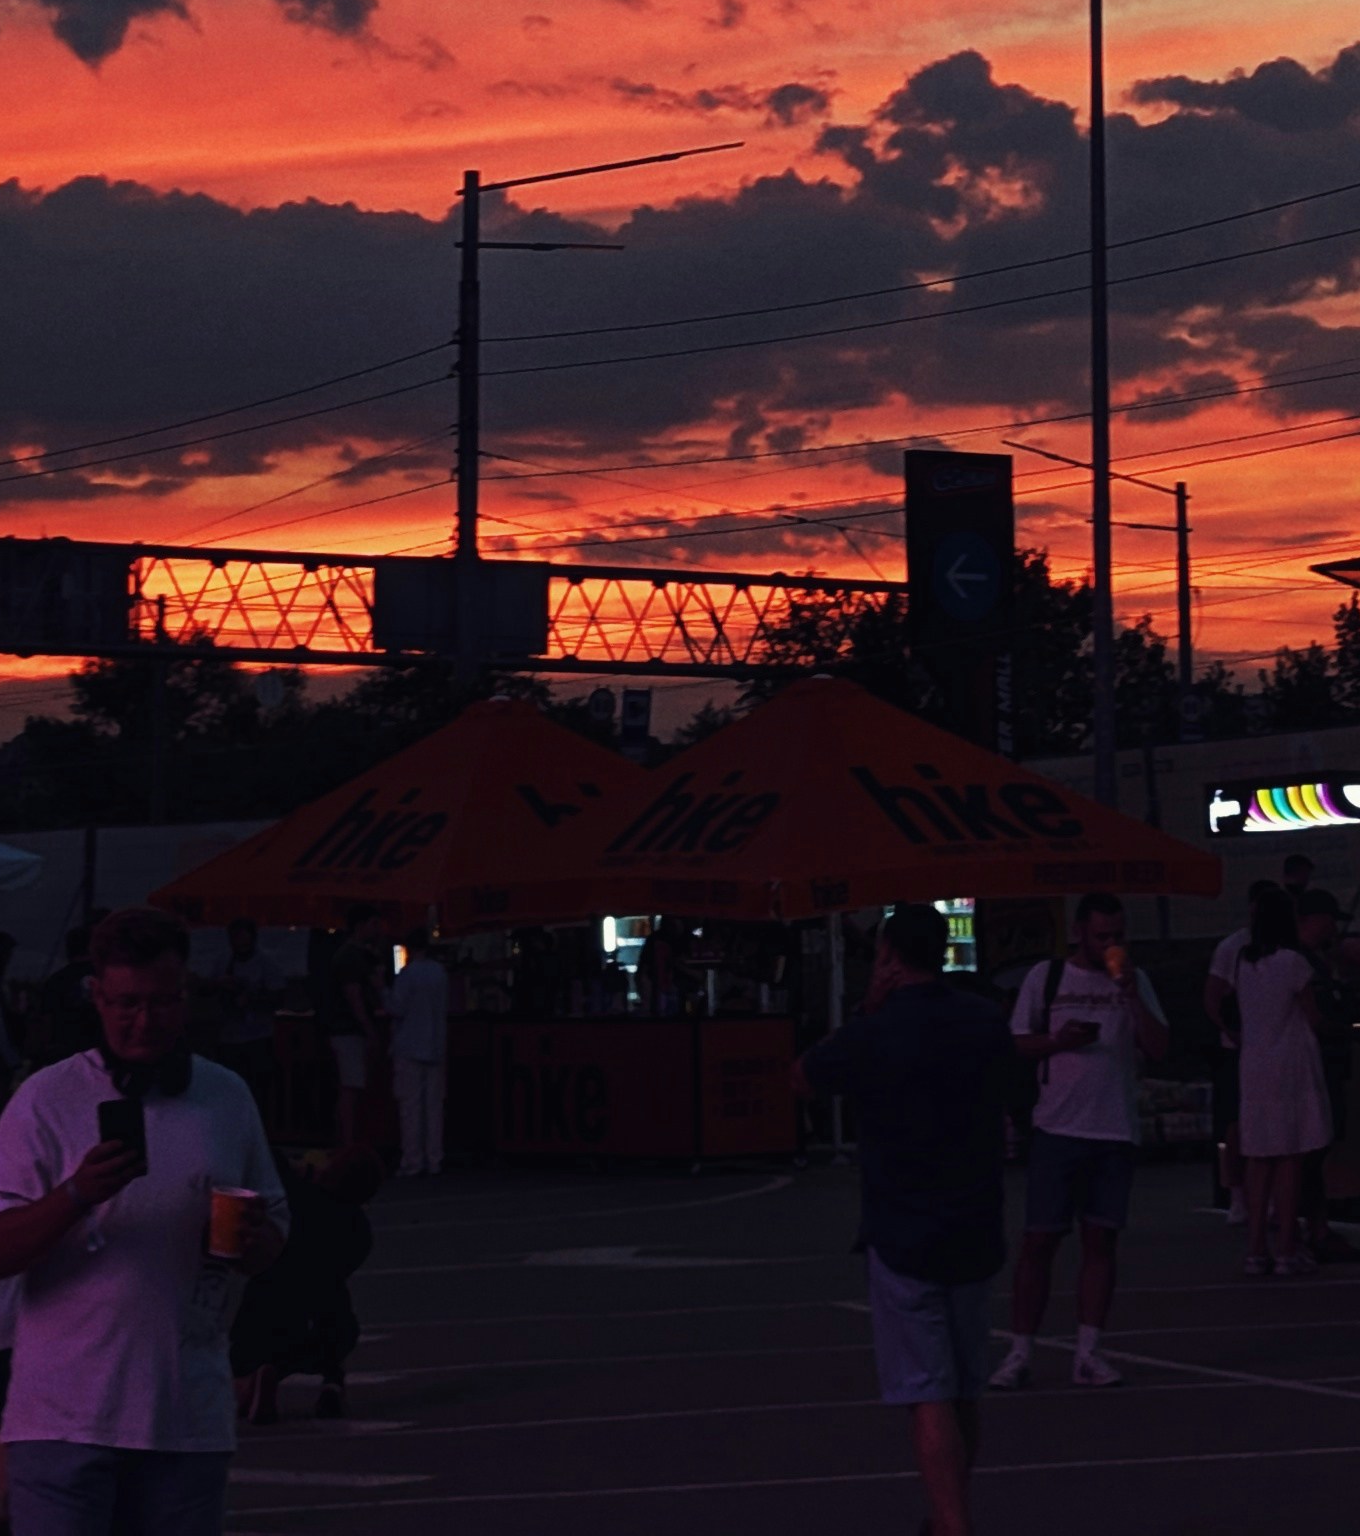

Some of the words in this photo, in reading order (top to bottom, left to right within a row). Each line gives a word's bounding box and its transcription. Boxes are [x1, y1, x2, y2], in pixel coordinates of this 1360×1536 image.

[293, 787, 447, 870] hike
[605, 770, 780, 854] hike
[849, 764, 1083, 843] hike
[501, 1034, 608, 1144] hike
